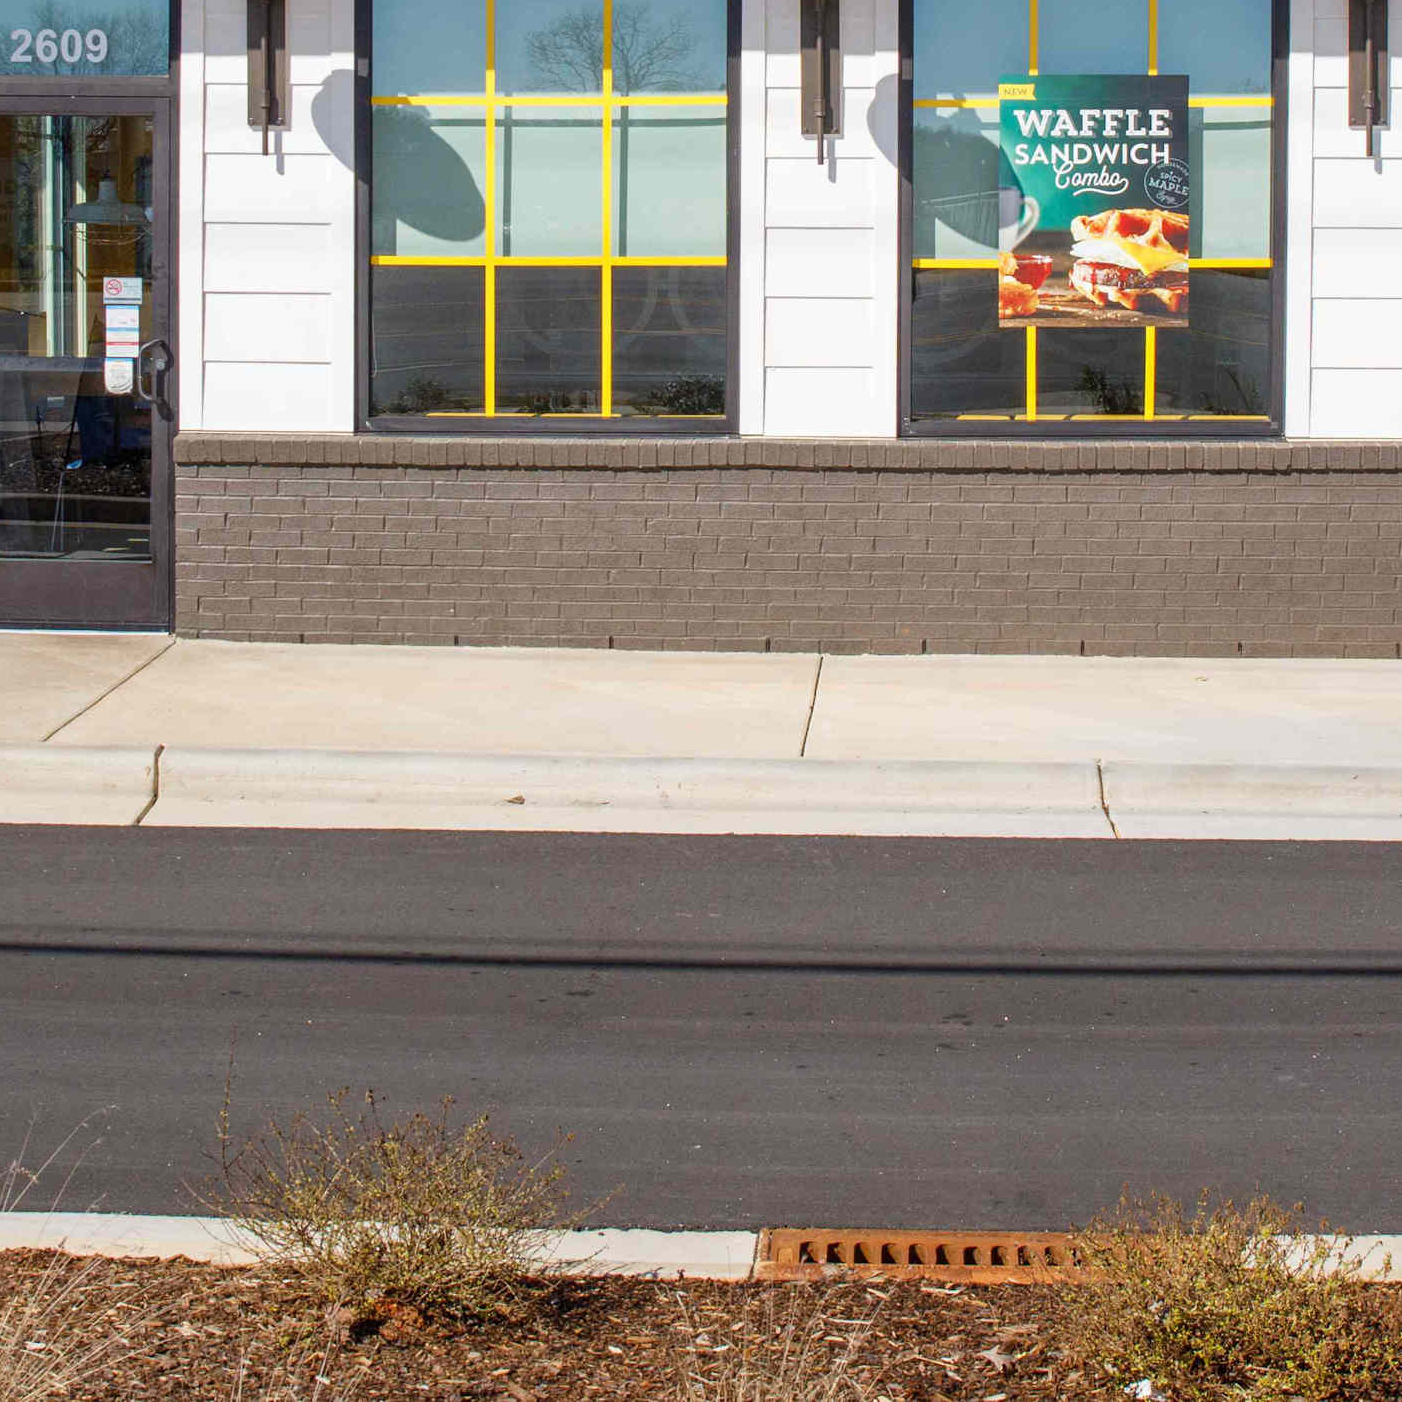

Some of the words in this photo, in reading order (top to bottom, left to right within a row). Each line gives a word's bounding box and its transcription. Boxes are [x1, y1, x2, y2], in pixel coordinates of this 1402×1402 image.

[10, 28, 108, 63] 2609
[1003, 87, 1028, 96] NEW
[1013, 109, 1172, 138] WAFFLE
[1014, 143, 1170, 165] SANDWICH
[1053, 159, 1130, 196] Combo
[1148, 177, 1189, 196] MAPLE
[1160, 171, 1183, 184] SPICY
